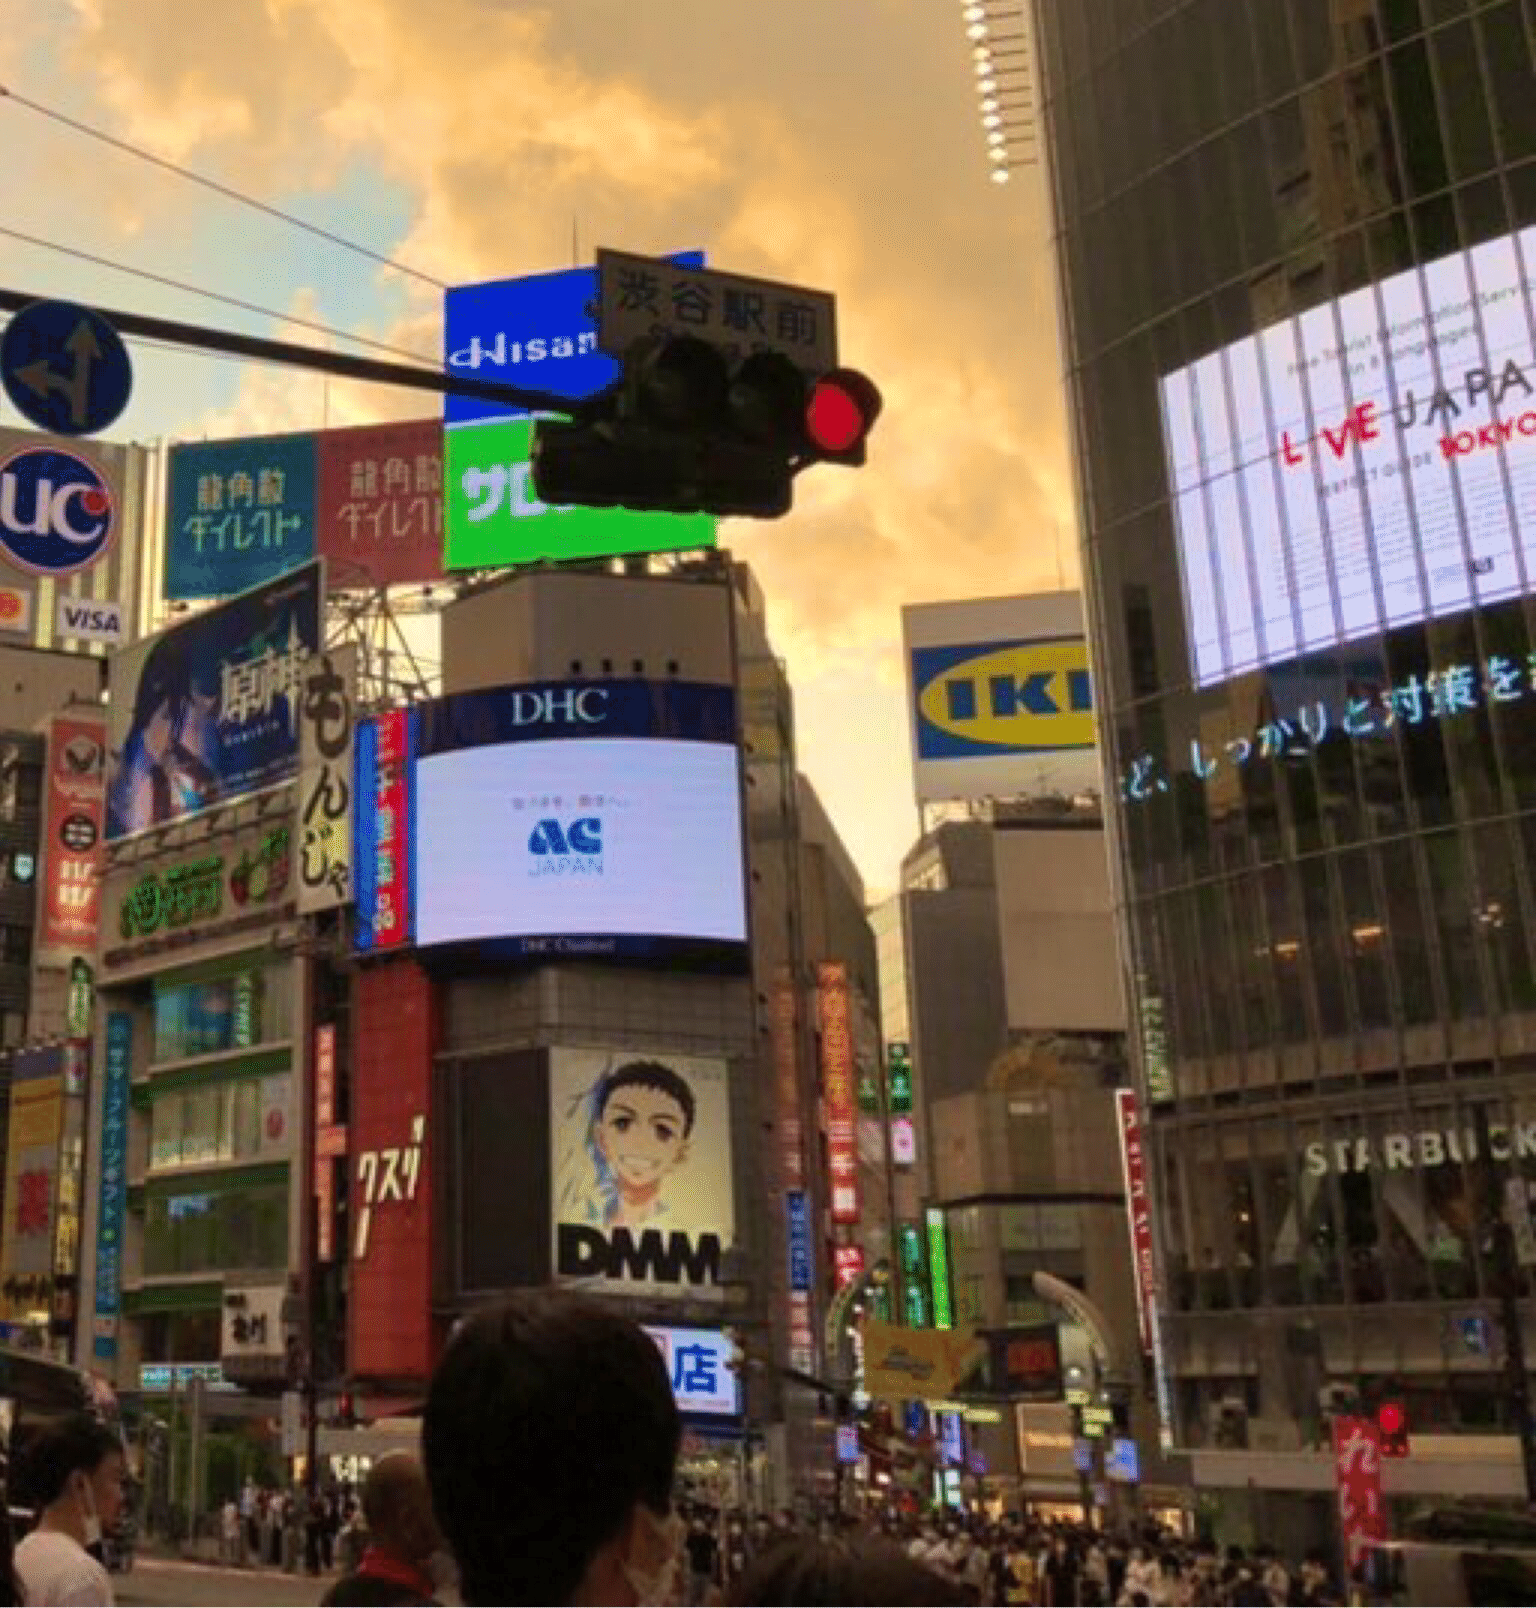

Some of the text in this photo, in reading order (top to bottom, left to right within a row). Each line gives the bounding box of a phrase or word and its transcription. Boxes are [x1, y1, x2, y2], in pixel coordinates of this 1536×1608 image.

[617, 267, 816, 345] 渋谷駅前
[1281, 401, 1380, 466] LVE
[1437, 412, 1536, 460] TOKYO
[66, 606, 120, 633] VISA
[511, 688, 609, 726] DHC
[302, 655, 352, 898] もんじゃ
[528, 817, 602, 855] AC
[528, 857, 604, 877] JAPAN
[558, 1222, 721, 1284] DMM
[673, 1343, 718, 1393] 店
